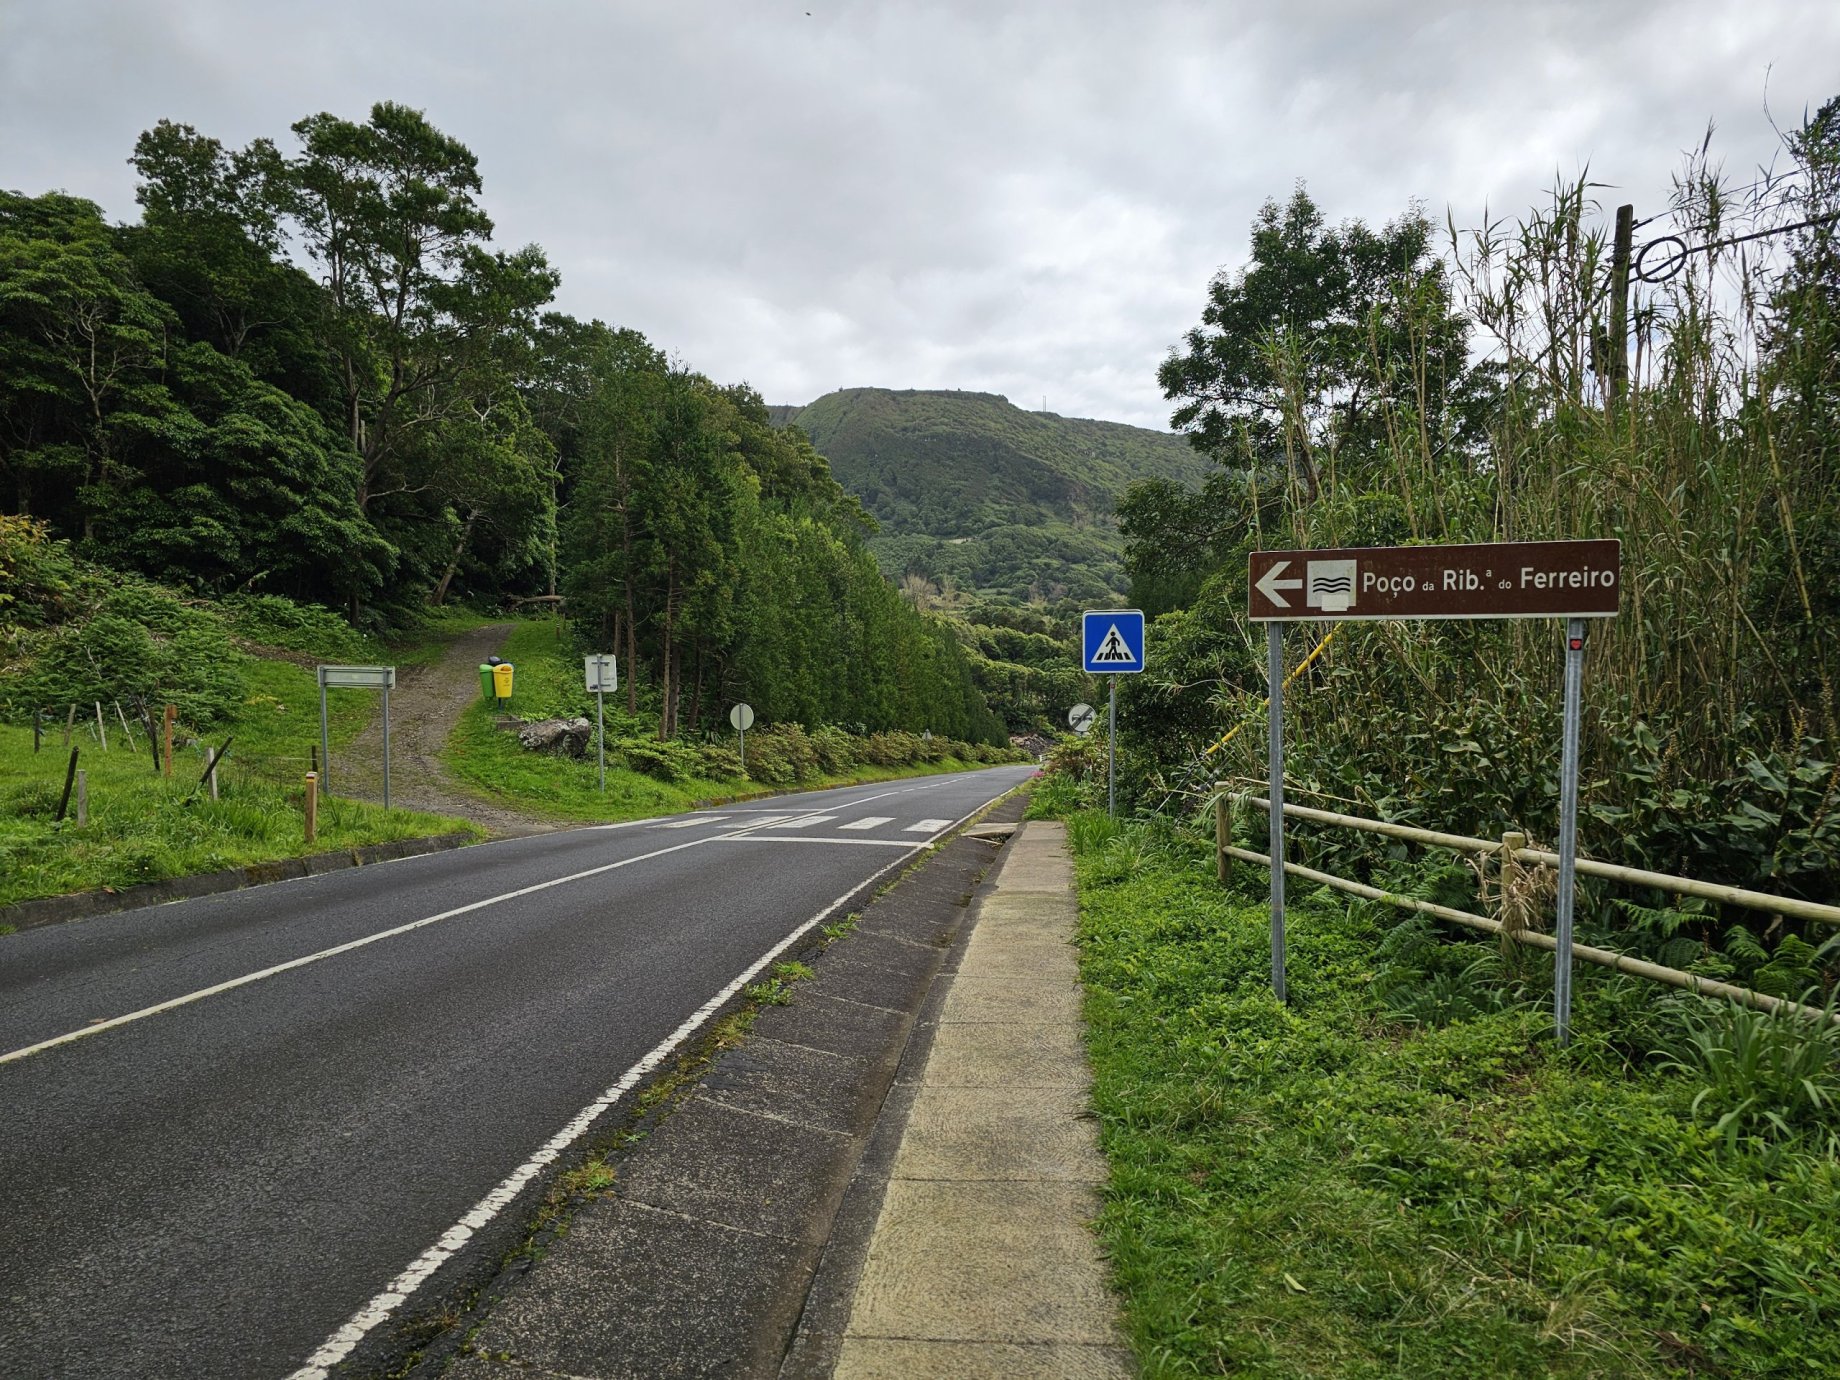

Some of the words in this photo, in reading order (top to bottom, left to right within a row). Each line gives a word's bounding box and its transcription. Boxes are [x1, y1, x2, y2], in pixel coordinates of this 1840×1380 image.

[1363, 572, 1415, 598] Poço
[1422, 580, 1434, 591] da
[1498, 578, 1512, 590] do
[1520, 566, 1615, 589] Ferreiro
